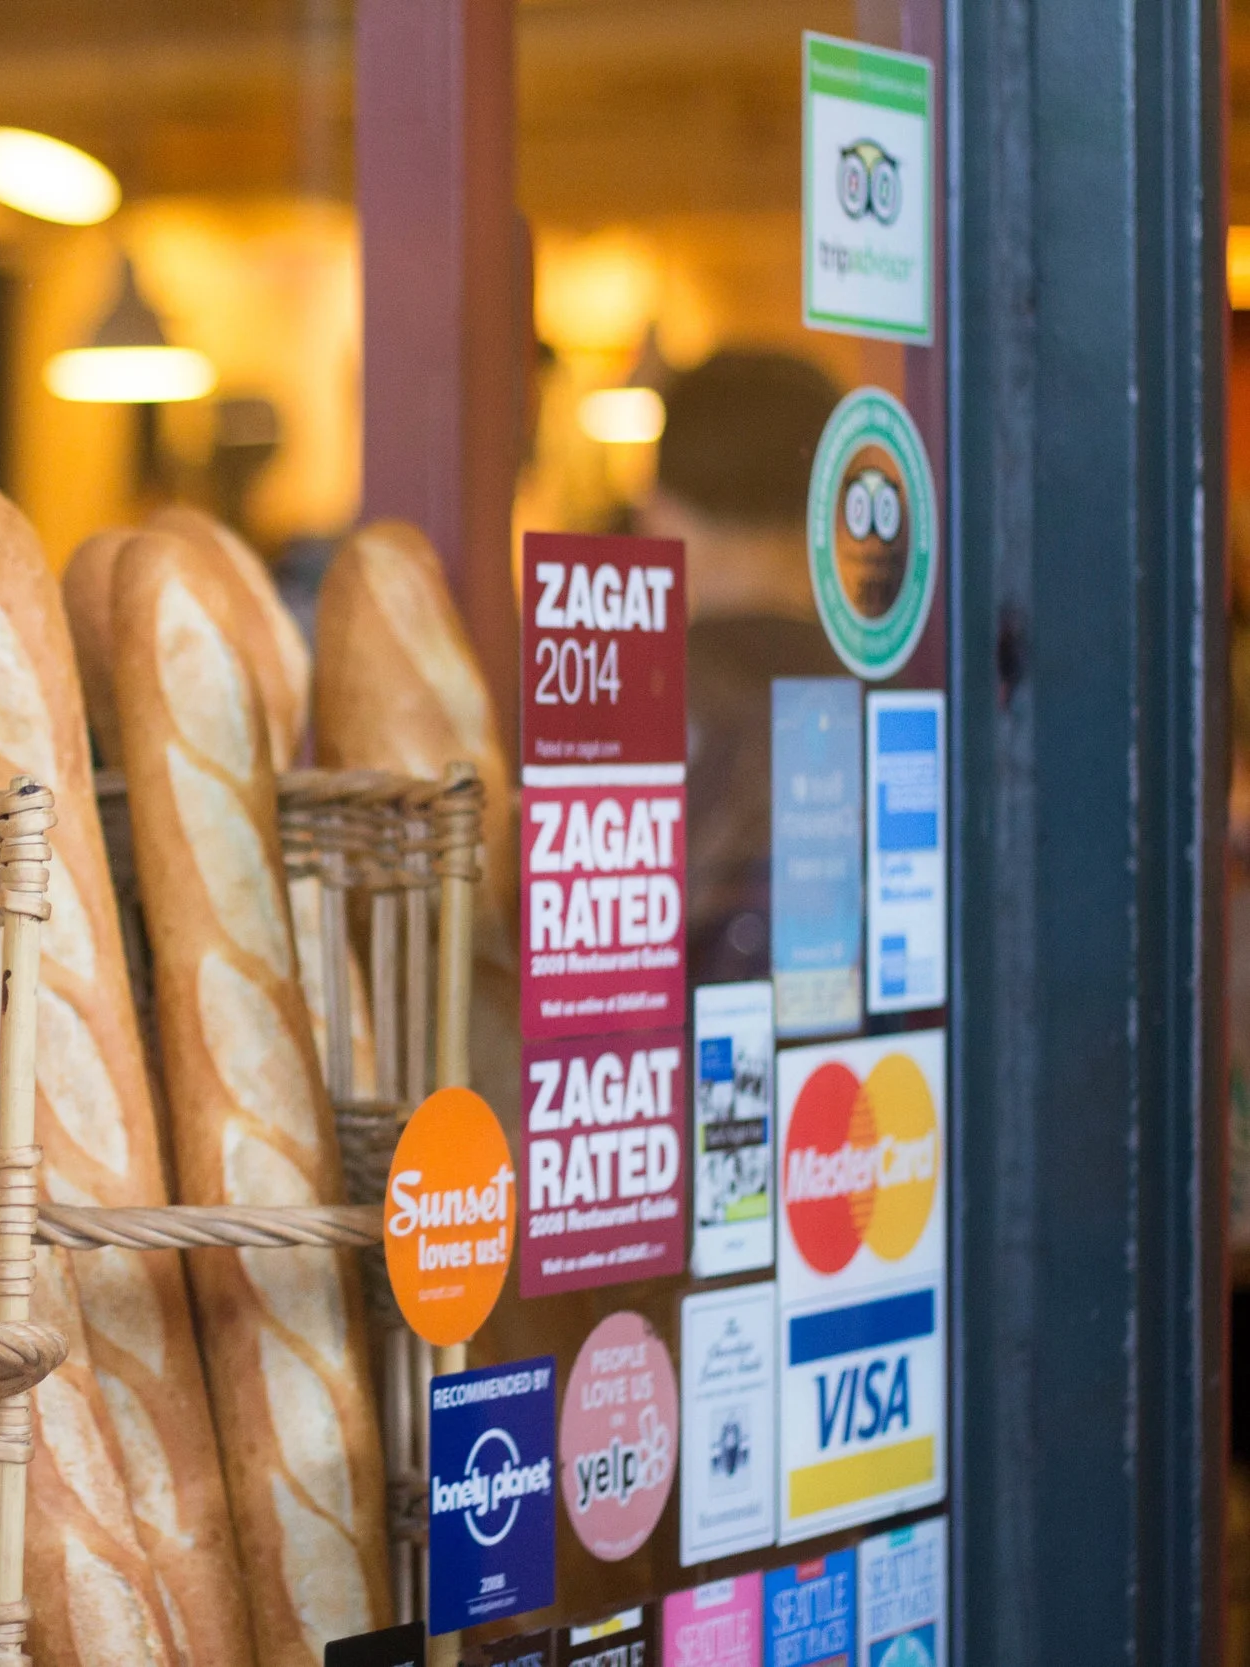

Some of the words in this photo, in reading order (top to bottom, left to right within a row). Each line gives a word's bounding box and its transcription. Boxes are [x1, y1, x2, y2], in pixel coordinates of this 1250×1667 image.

[534, 562, 675, 633] ZAGAT
[534, 637, 621, 705] 2014
[529, 796, 683, 874] ZAGAT
[529, 873, 682, 953] RATED
[566, 949, 639, 975] Restaurant
[528, 1046, 680, 1133] ZAGAT
[388, 1163, 516, 1237] Sunset
[528, 1123, 680, 1212] RATED
[784, 1128, 937, 1205] MasterCard
[418, 1234, 472, 1272] loves
[475, 1226, 507, 1267] us!
[566, 1202, 639, 1235] Restaurant
[432, 1375, 532, 1411] RECOMMENDED
[533, 1367, 551, 1392] BY
[580, 1375, 626, 1411] LOVE
[630, 1370, 654, 1403] US
[591, 1341, 647, 1375] PEOPLE
[815, 1355, 911, 1450] VISA
[432, 1466, 490, 1518] lonely
[491, 1456, 552, 1511] planet
[576, 1439, 639, 1511] yelp
[772, 1571, 849, 1637] SEATTLE
